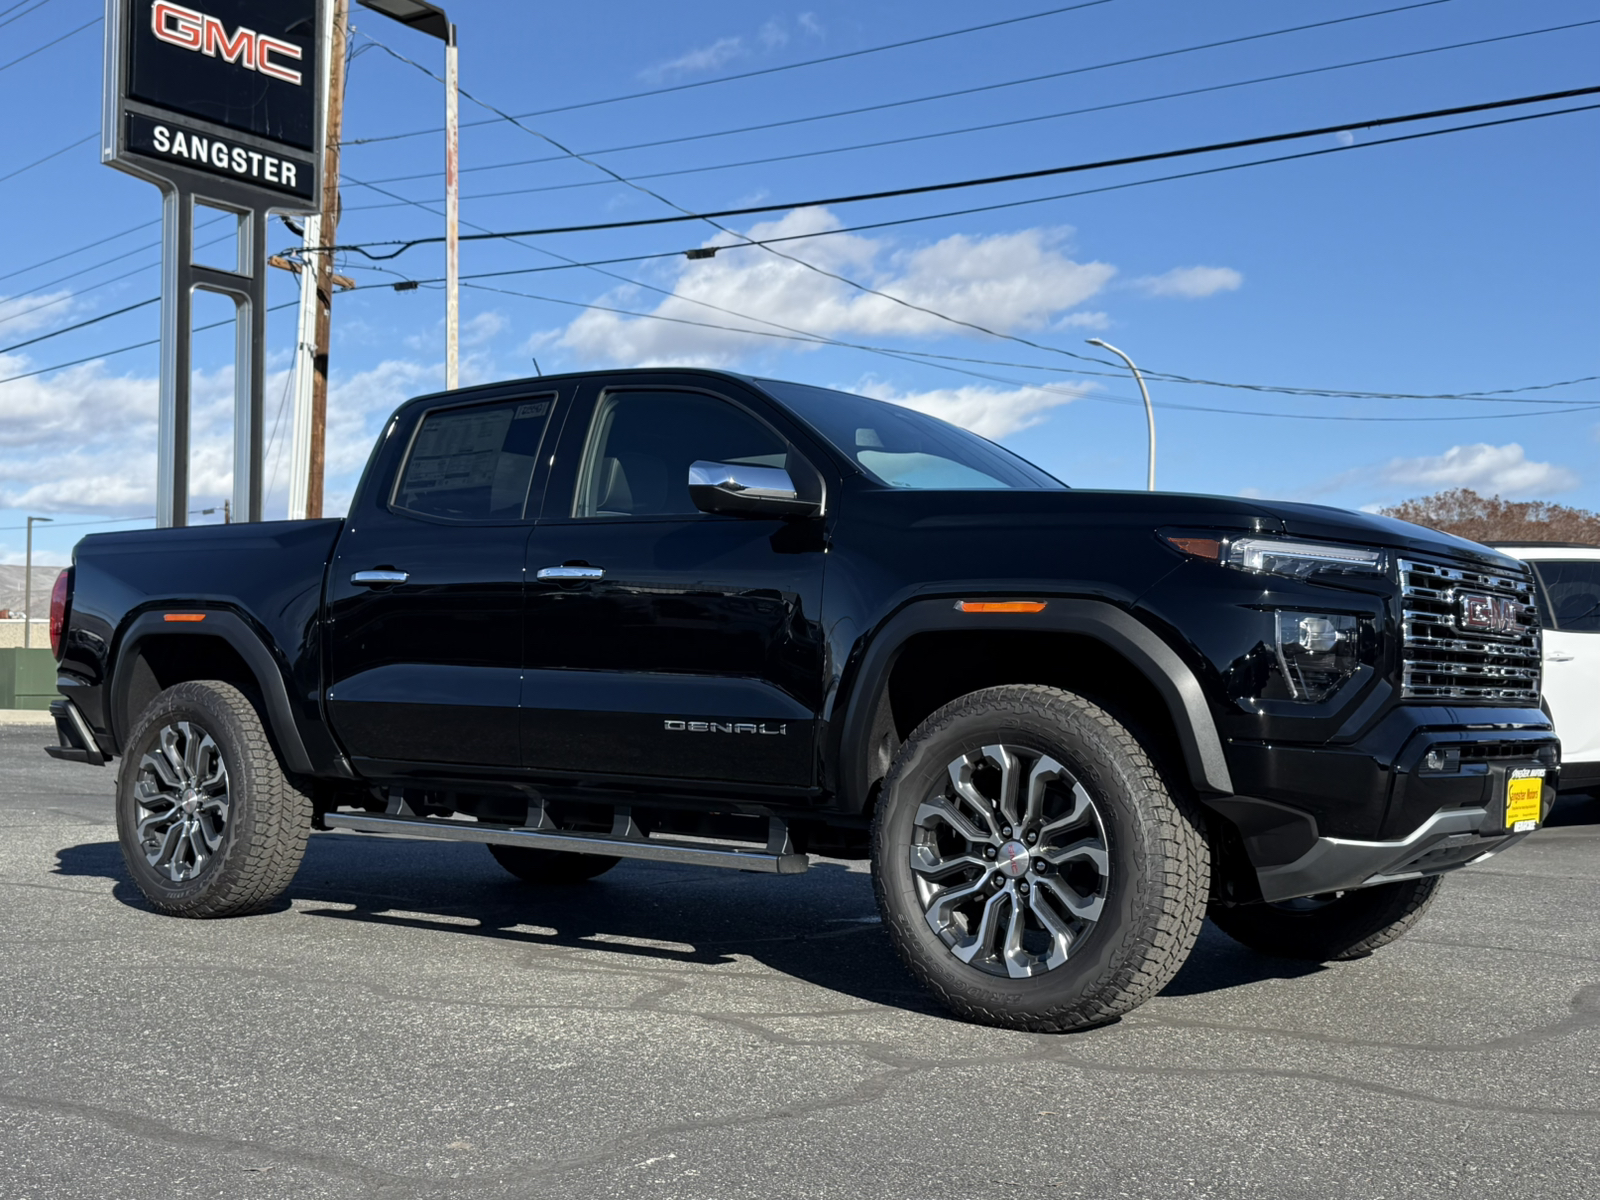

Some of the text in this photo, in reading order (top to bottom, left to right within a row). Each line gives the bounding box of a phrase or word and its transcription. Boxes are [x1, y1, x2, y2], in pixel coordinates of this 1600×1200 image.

[152, 0, 302, 86] GMC
[153, 125, 297, 187] SANGSTER
[1461, 594, 1527, 633] GMC
[664, 720, 786, 735] DENALI
